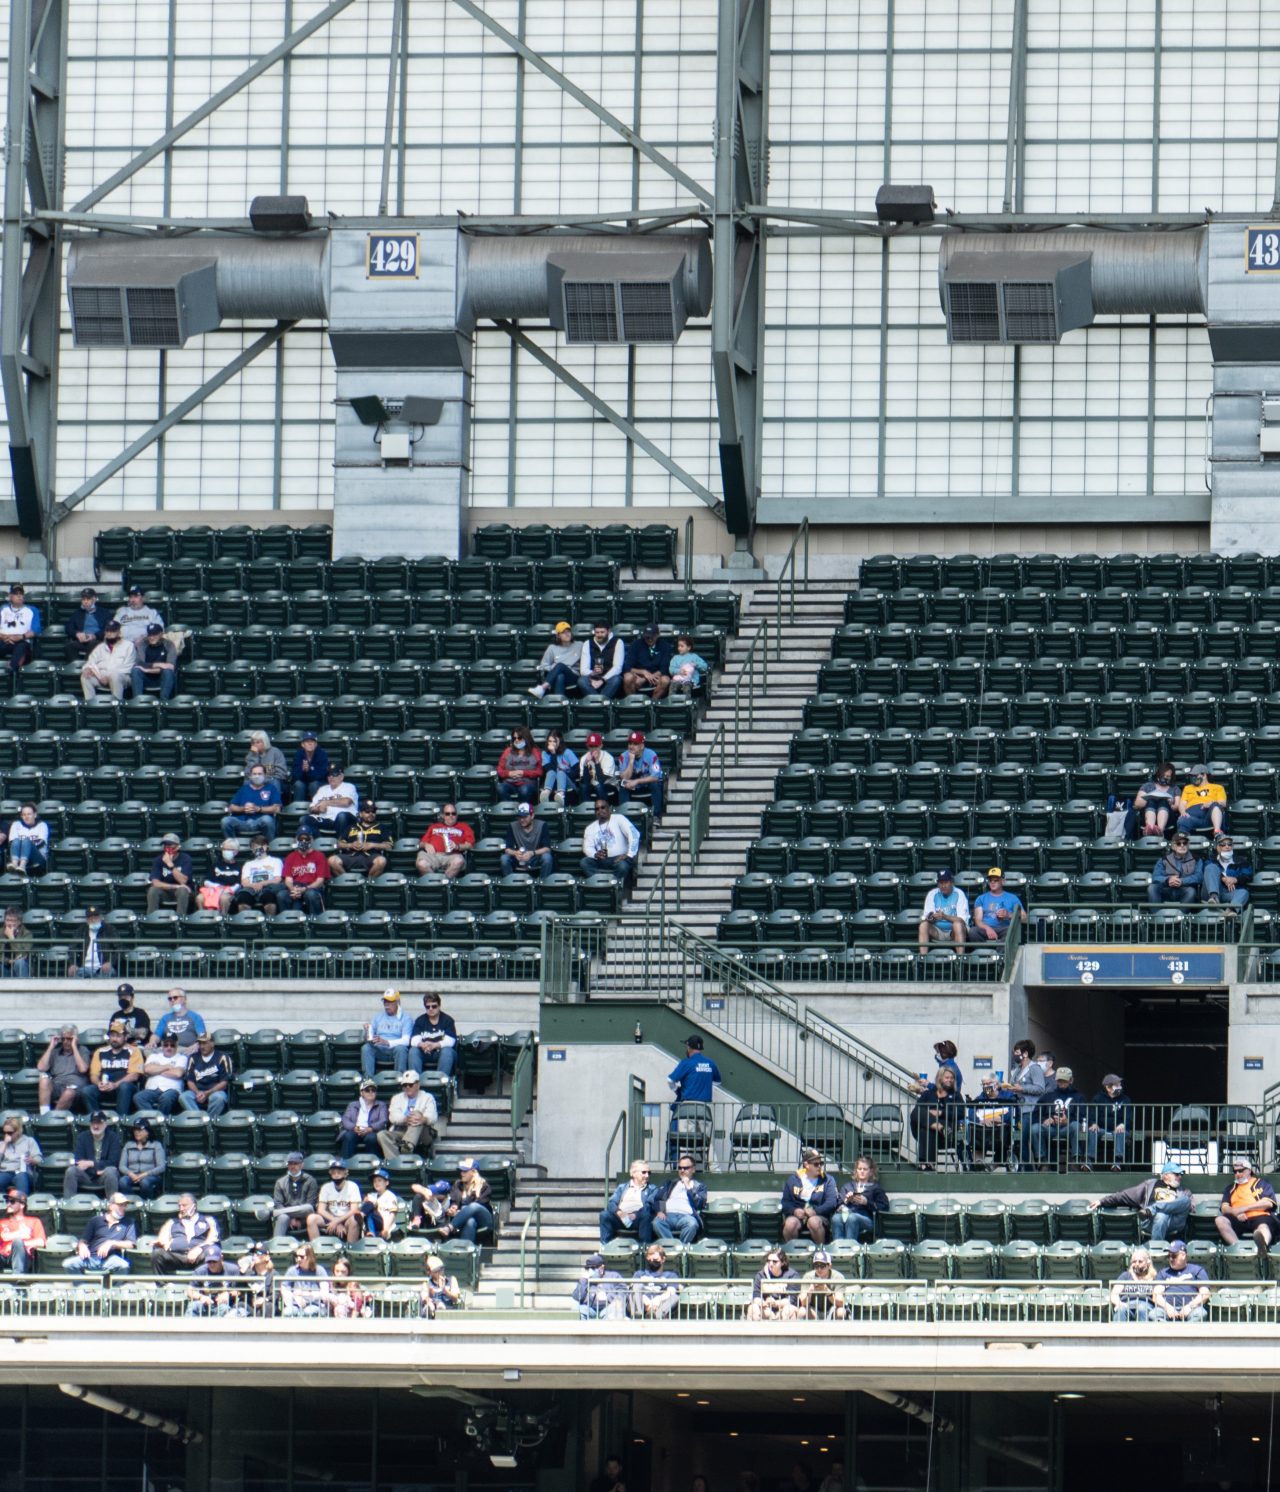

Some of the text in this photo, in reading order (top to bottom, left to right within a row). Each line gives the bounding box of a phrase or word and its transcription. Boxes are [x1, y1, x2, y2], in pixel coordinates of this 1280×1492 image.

[370, 240, 416, 272] 429
[1076, 961, 1100, 971] 429
[1167, 961, 1189, 971] 431
